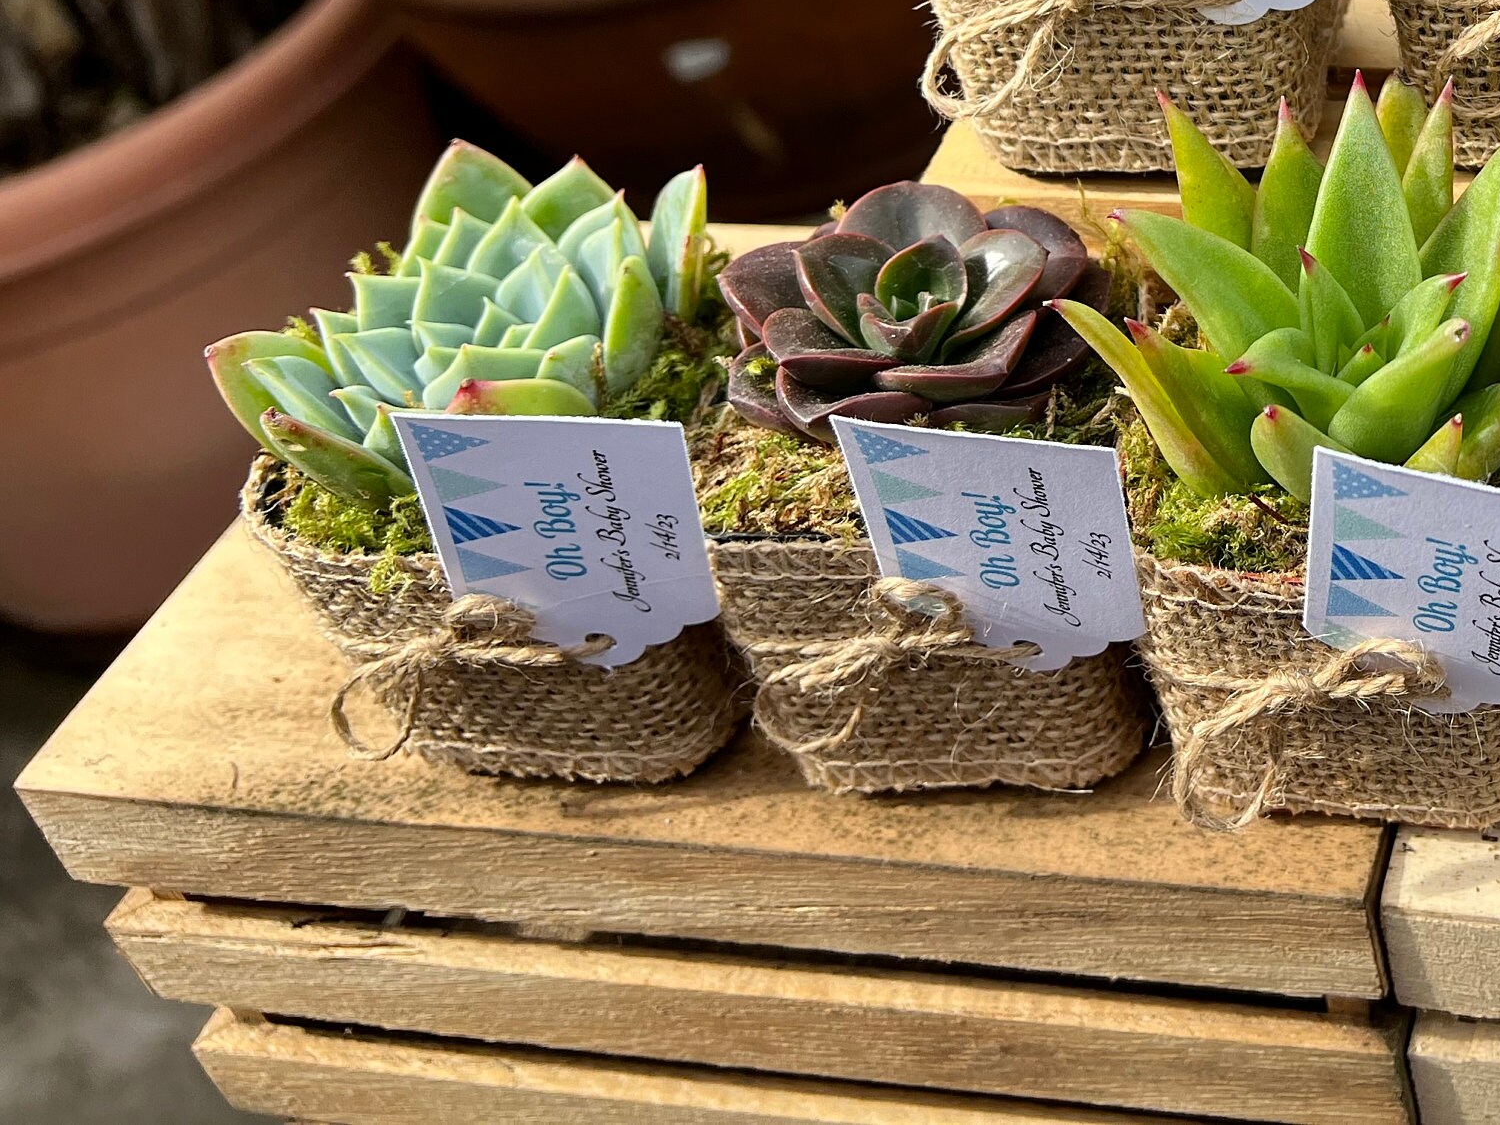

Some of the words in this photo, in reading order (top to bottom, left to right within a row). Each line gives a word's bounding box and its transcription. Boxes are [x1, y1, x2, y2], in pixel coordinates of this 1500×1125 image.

[577, 450, 616, 502] Shower
[1013, 467, 1051, 517] Shower
[524, 481, 581, 538] Boy!
[585, 506, 630, 546] Baby
[961, 492, 1016, 548] Boy!
[645, 514, 679, 560] 2/14/23
[1020, 520, 1064, 561] Baby
[1078, 532, 1112, 579] 2/14/23
[545, 543, 588, 581] Oh
[601, 550, 652, 612] Jennifer's
[980, 555, 1020, 589] Oh
[1417, 537, 1479, 594] Boy!
[1032, 564, 1082, 627] Jennifer's
[1413, 598, 1455, 633] Oh
